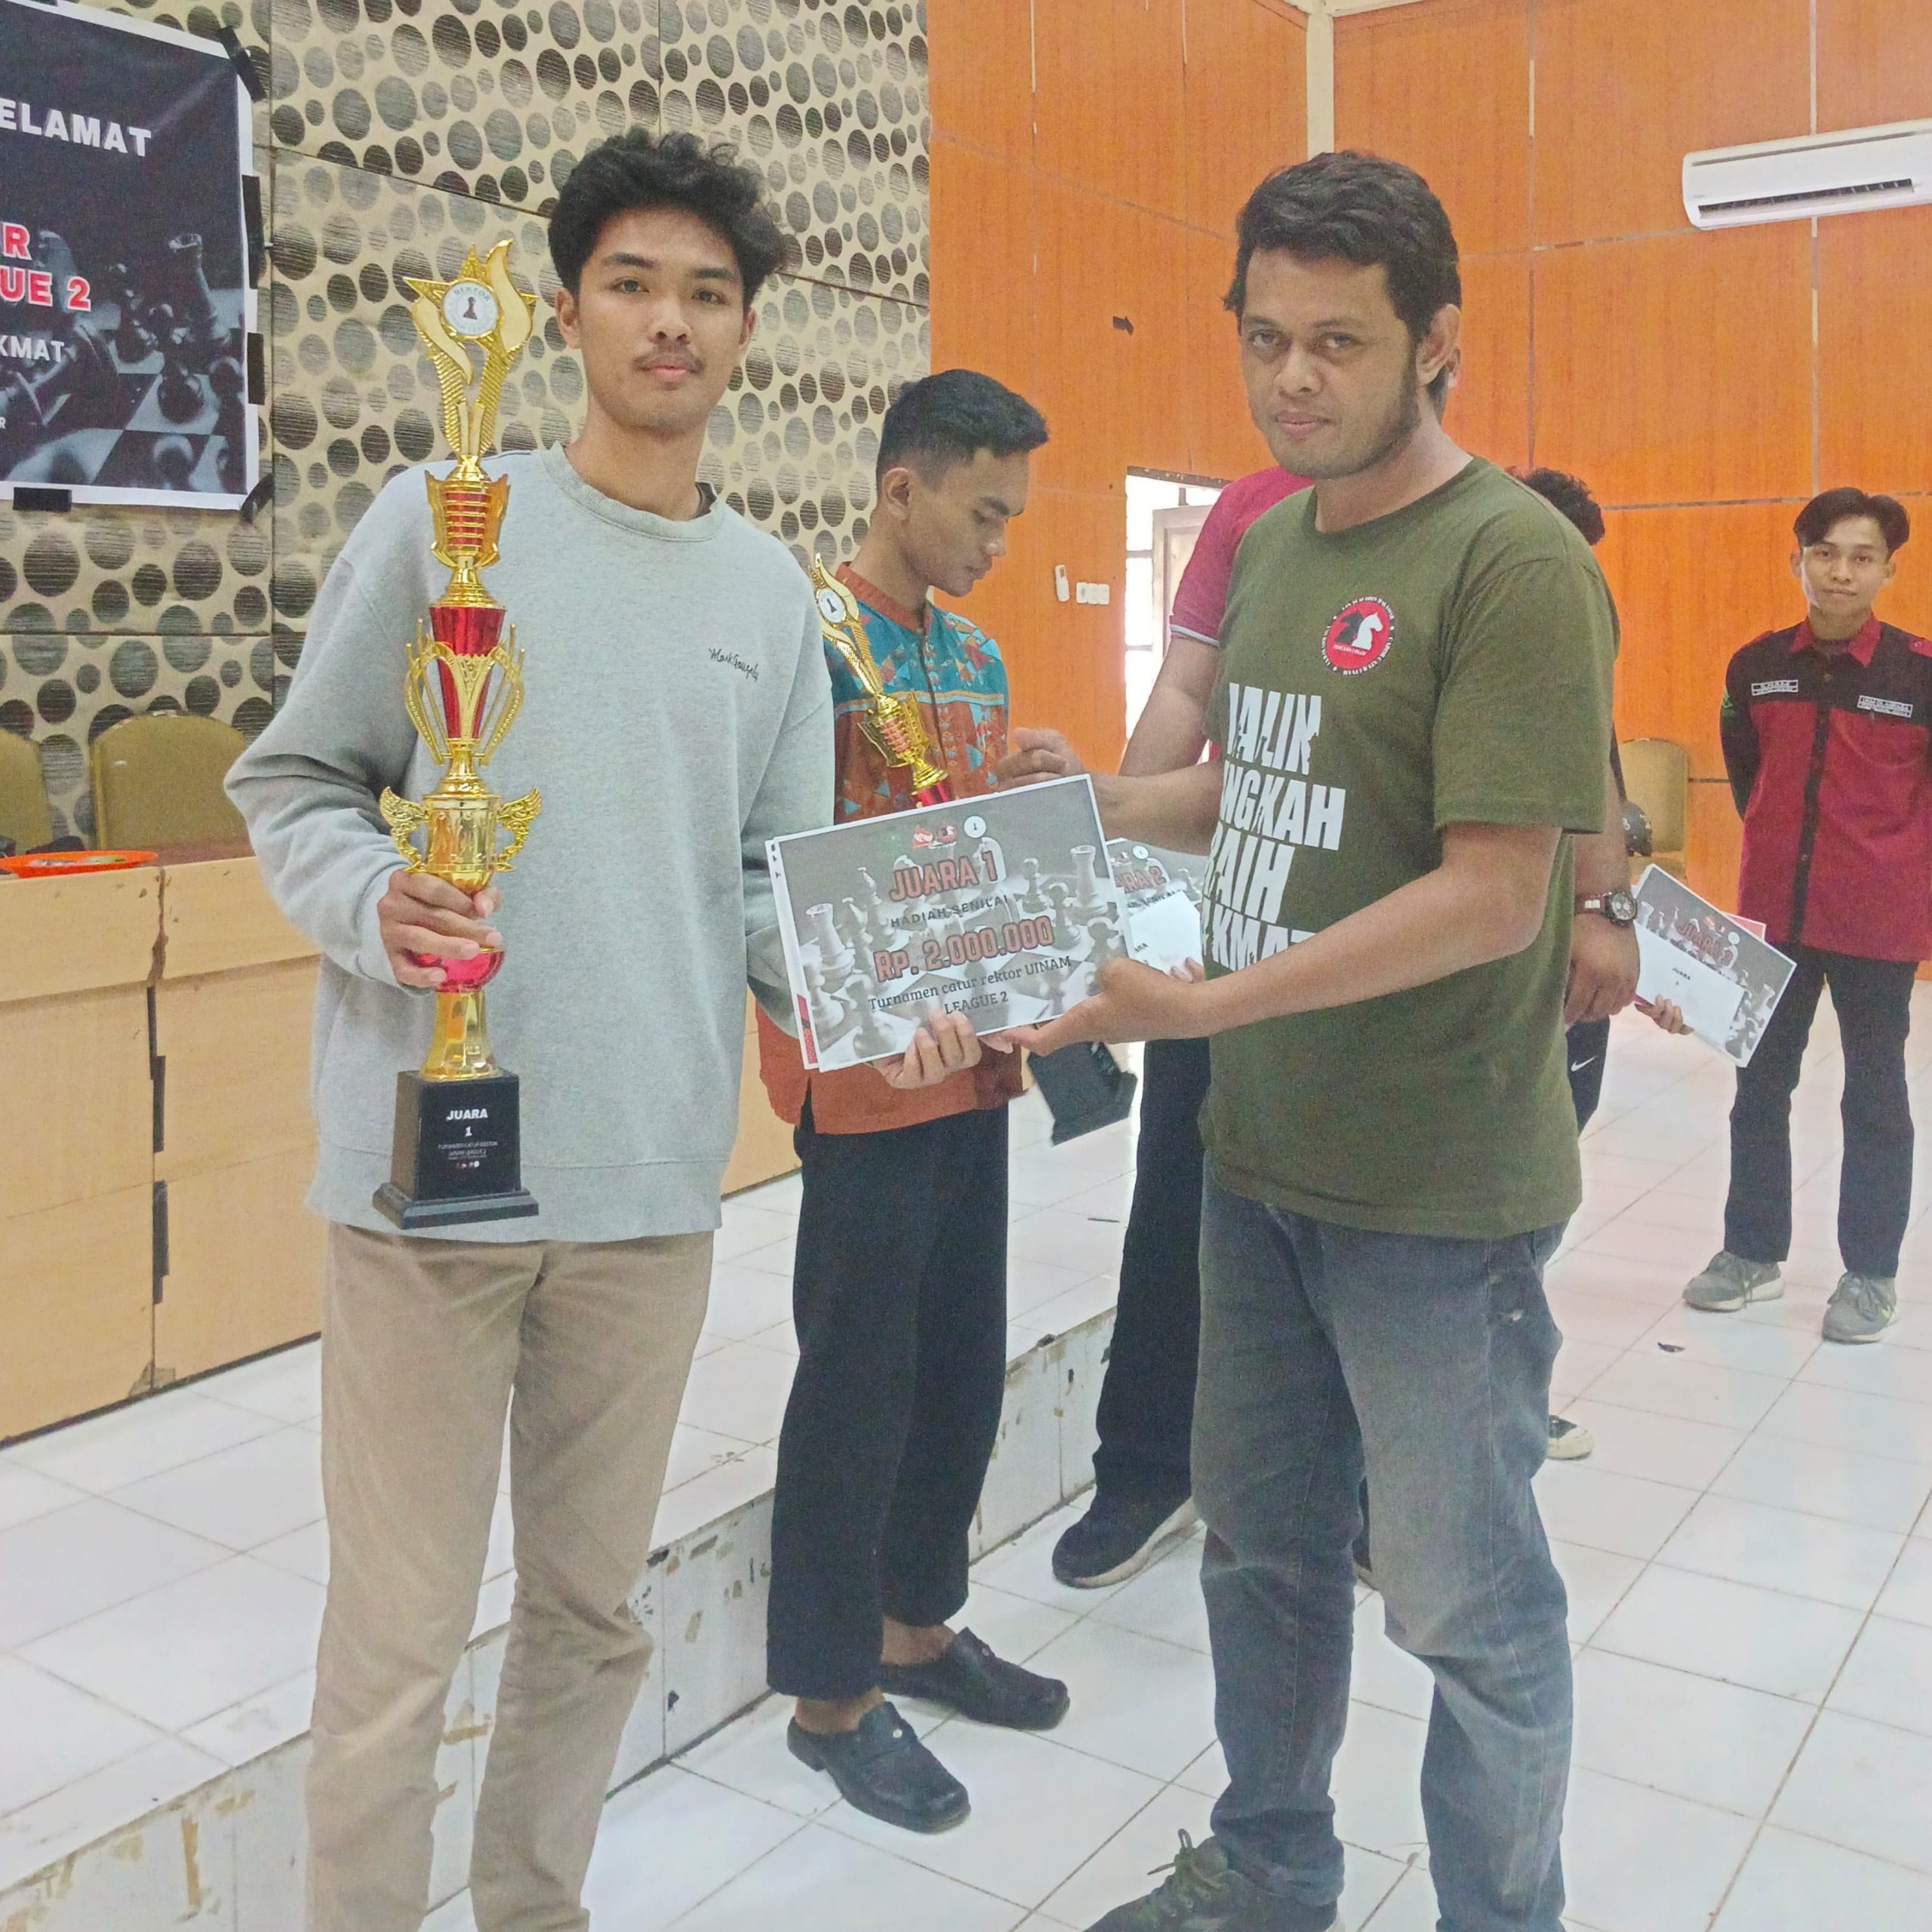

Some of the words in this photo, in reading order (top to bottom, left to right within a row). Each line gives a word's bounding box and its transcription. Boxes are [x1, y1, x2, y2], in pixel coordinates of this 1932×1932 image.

[67, 275, 91, 312] 2
[889, 855, 980, 902] JUARA
[982, 850, 998, 881] 1
[891, 908, 946, 928] HADIAH
[952, 894, 1008, 915] SENILAI
[922, 915, 1054, 972] 2.000.000
[868, 986, 939, 1010] Turnamen
[941, 979, 977, 994] catur
[981, 968, 1023, 986] rektor
[1025, 955, 1072, 976] UINAM
[944, 993, 998, 1015] LEAGUE
[1000, 991, 1009, 1003] 2
[446, 1109, 488, 1121] JUARA
[465, 1126, 472, 1137] 1
